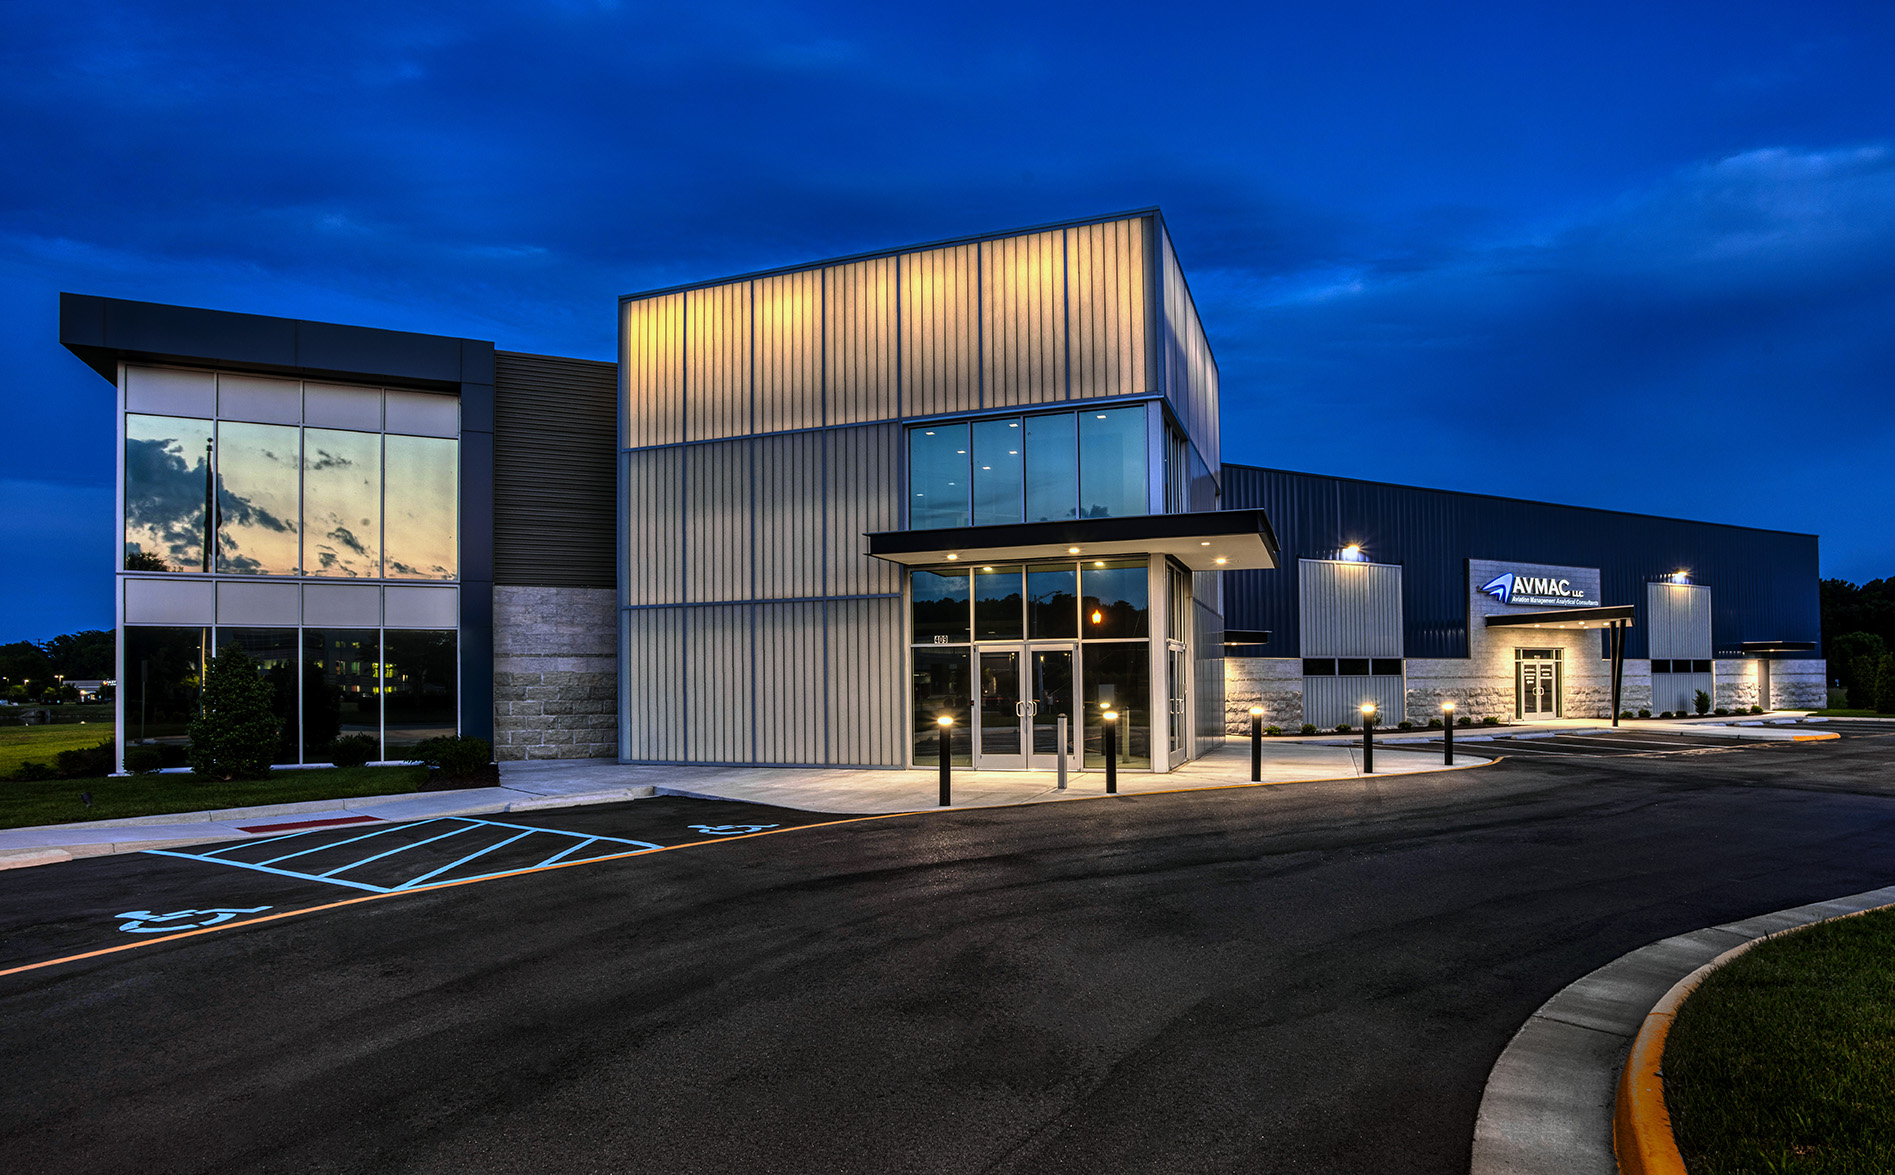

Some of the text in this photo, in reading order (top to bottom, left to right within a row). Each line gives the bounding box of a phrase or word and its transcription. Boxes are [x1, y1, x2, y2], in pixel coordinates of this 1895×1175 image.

[1513, 576, 1584, 598] AVMAC LLC
[1530, 597, 1555, 605] Management
[934, 635, 948, 644] 409
